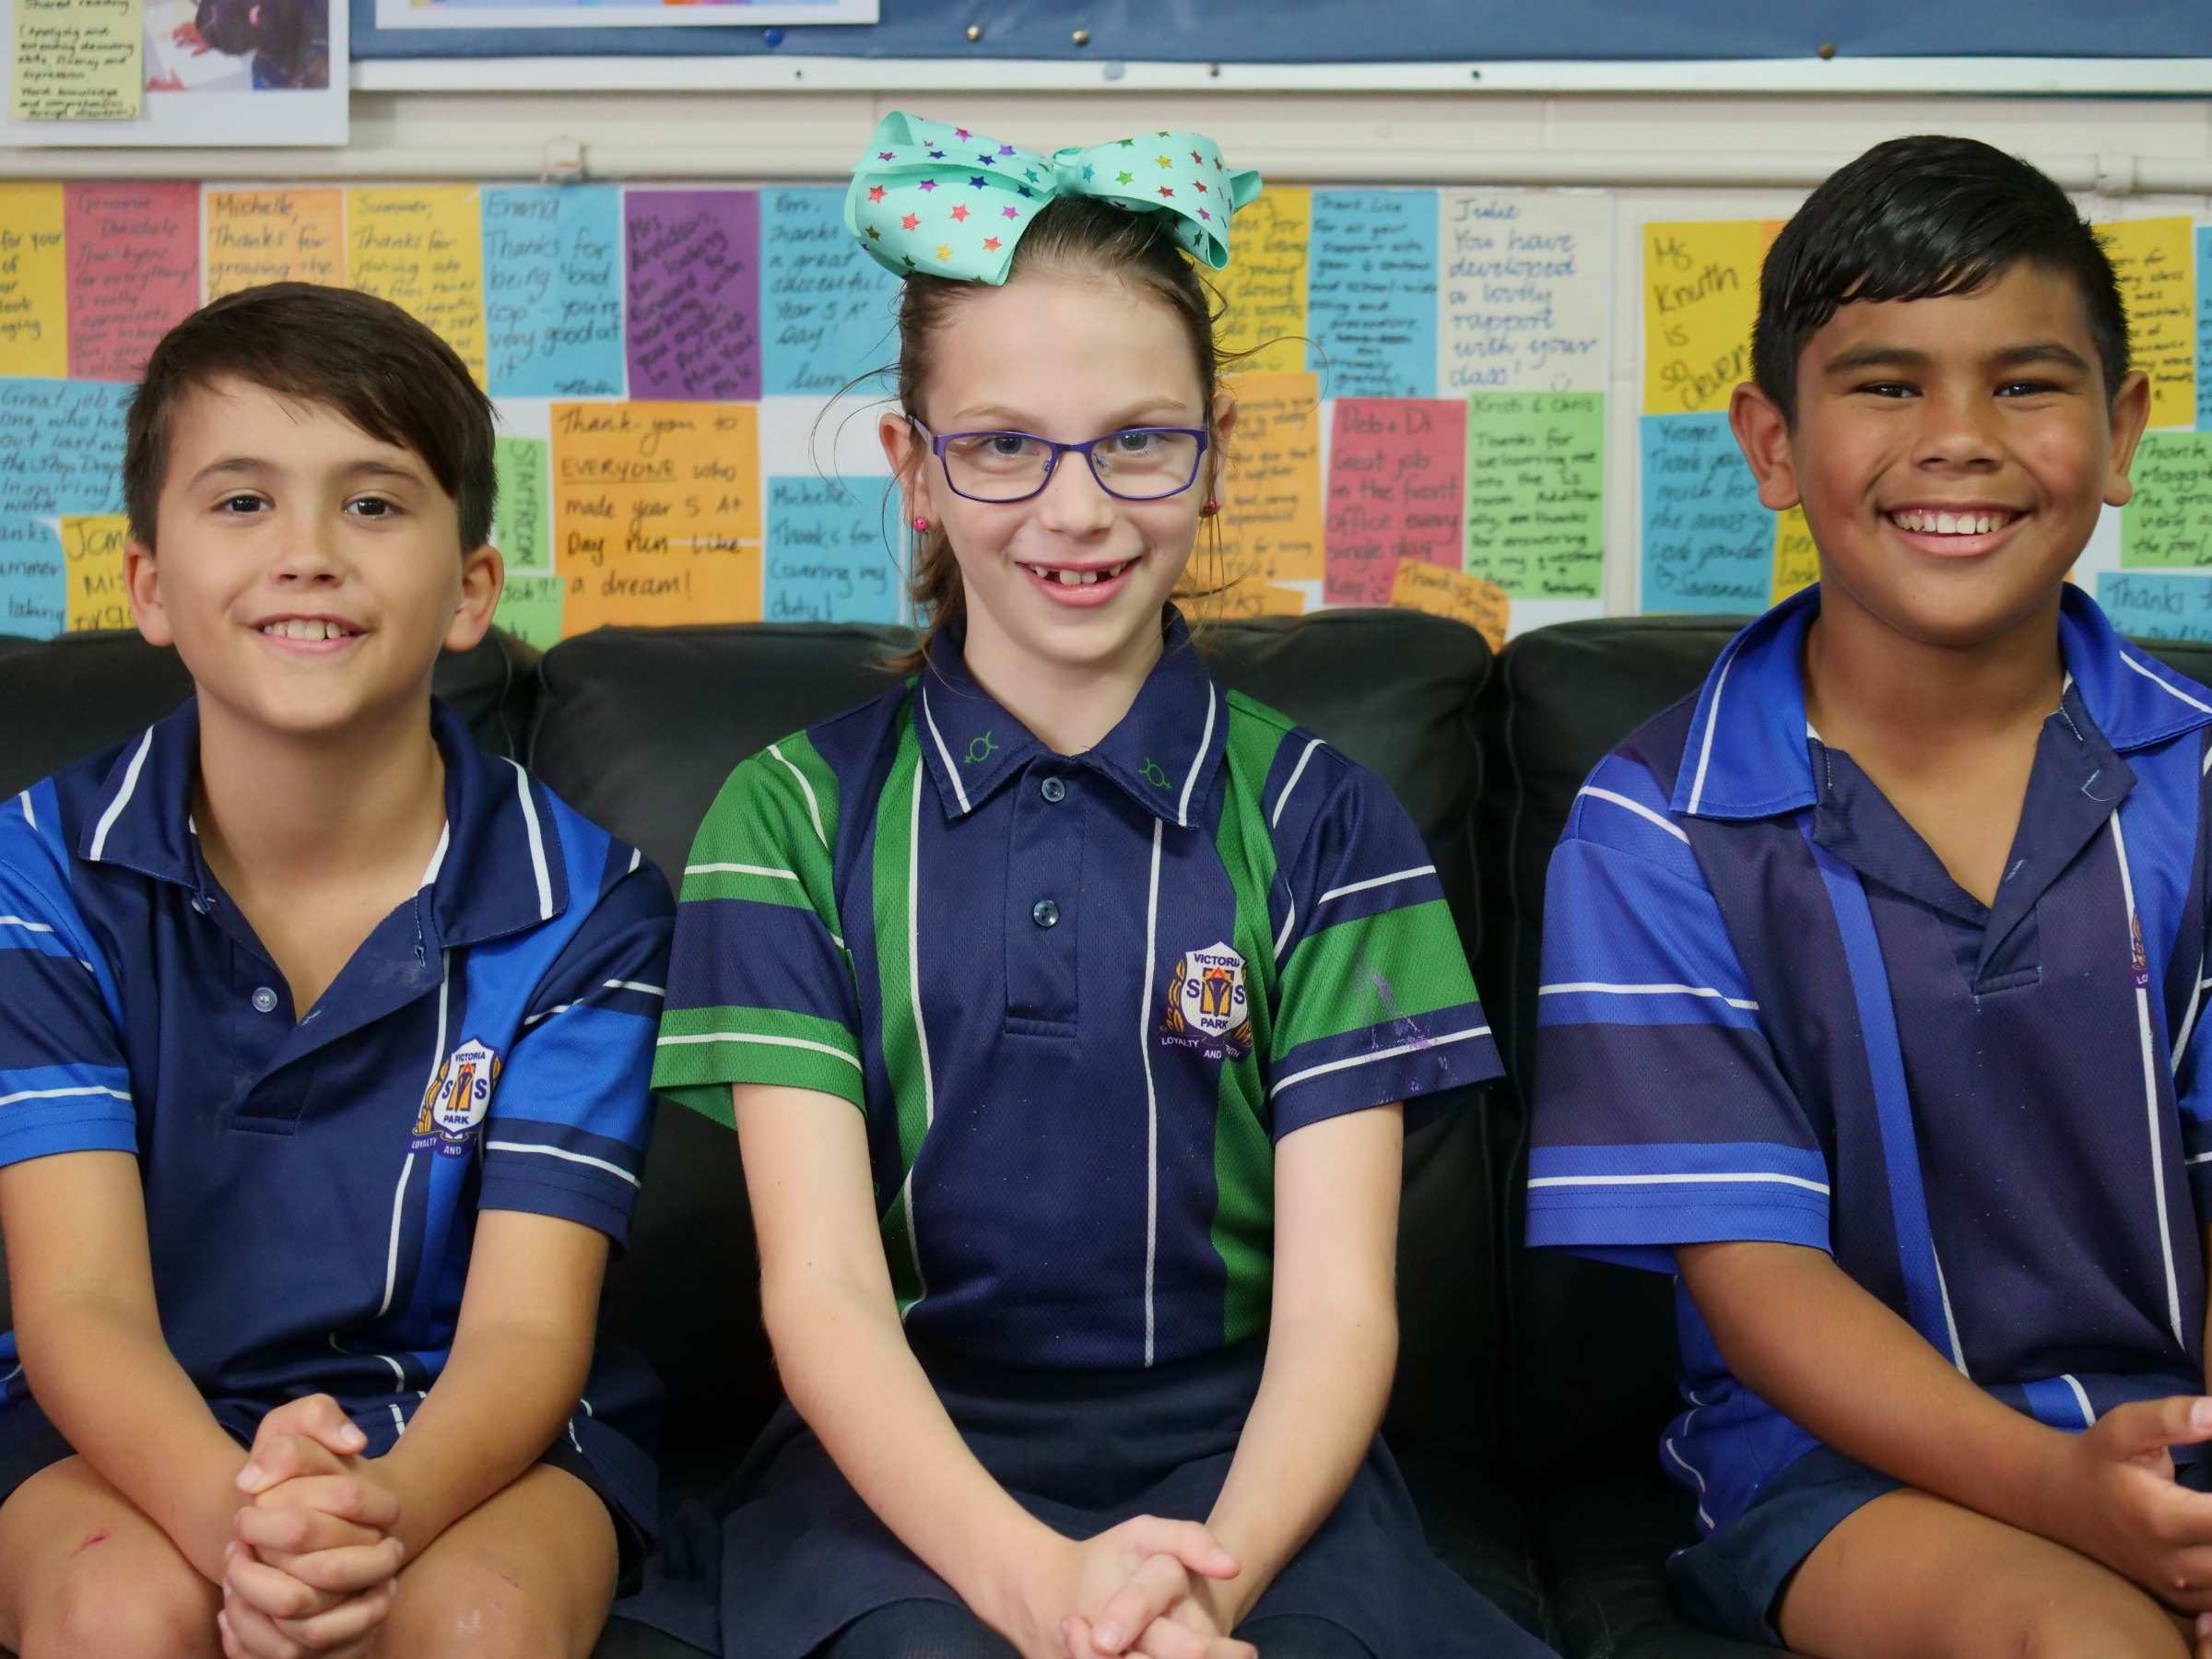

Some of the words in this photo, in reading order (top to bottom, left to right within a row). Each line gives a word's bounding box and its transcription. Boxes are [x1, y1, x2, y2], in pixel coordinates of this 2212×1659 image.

[209, 224, 288, 251] Thanks
[298, 226, 332, 252] for
[354, 227, 421, 252] Thanks
[428, 229, 457, 253] for
[486, 229, 561, 261] Thanks
[574, 226, 612, 259] for
[1453, 229, 1495, 252] You
[1507, 229, 1575, 252] have
[793, 250, 857, 275] great
[1448, 253, 1576, 279] developed
[489, 269, 551, 304] being
[1449, 289, 1468, 305] a
[826, 300, 840, 321] 5
[488, 328, 536, 361] very
[545, 322, 595, 358] good
[1664, 324, 1690, 347] is
[1453, 335, 1515, 359] with
[1527, 336, 1598, 371] your
[497, 359, 518, 379] it
[1660, 359, 1688, 392] so
[1, 385, 69, 409] Great
[75, 387, 109, 420] job
[560, 406, 636, 435] Thank
[641, 420, 696, 457] you
[713, 416, 737, 431] to
[1547, 427, 1574, 450] for
[1649, 448, 1700, 473] Thank
[2137, 436, 2208, 460] Thank
[561, 458, 677, 481] EVERYONE
[692, 460, 736, 482] who
[1393, 450, 1430, 481] job
[1359, 481, 1394, 501] the
[1401, 476, 1459, 505] front
[564, 495, 616, 518] made
[685, 498, 700, 519] 5
[1649, 505, 1682, 532] the
[772, 519, 841, 548] Thanks
[849, 519, 878, 547] for
[1326, 507, 1394, 538] office
[568, 531, 606, 567] Day
[627, 535, 670, 555] run
[570, 577, 586, 594] a
[601, 570, 692, 600] dream!
[861, 565, 888, 597] my
[1186, 979, 1201, 998] S
[1233, 984, 1245, 1005] S
[1200, 1018, 1229, 1029] PARK
[455, 1052, 486, 1062] VICTORIA
[1161, 1037, 1200, 1048] LOYALTY
[1204, 1050, 1222, 1059] AND
[442, 1080, 453, 1099] S
[475, 1078, 488, 1100] S
[443, 1115, 469, 1124] PARK
[411, 1137, 438, 1149] LOYALTY
[443, 1146, 462, 1155] AND
